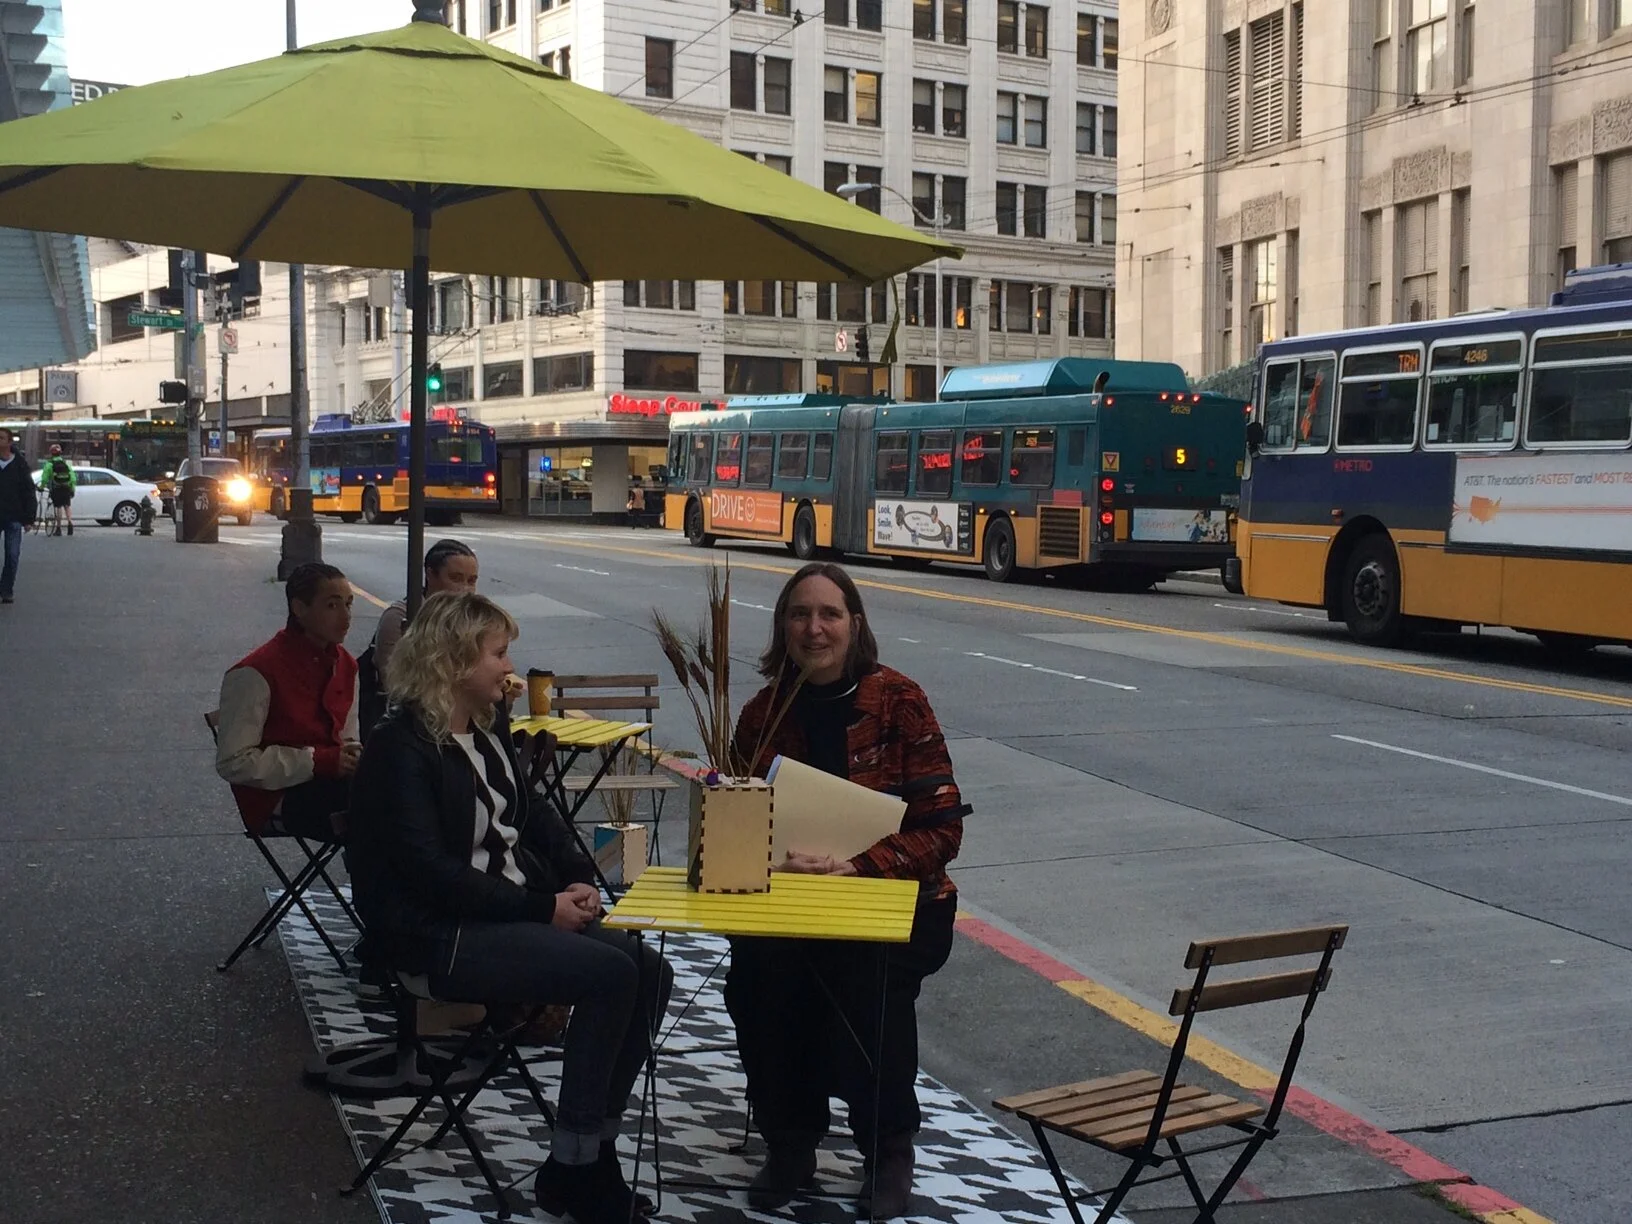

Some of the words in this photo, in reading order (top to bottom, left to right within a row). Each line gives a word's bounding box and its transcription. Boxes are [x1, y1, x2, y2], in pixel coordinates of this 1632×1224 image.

[131, 314, 163, 326] Stewart
[610, 394, 660, 417] Sleep
[1176, 448, 1186, 465] 5
[1340, 459, 1373, 471] METRO
[1487, 474, 1501, 486] The
[1502, 474, 1534, 486] nation's
[1535, 472, 1575, 485] FASTEST
[1574, 471, 1593, 484] and
[1593, 472, 1622, 484] MOST
[712, 493, 744, 521] DRIVE
